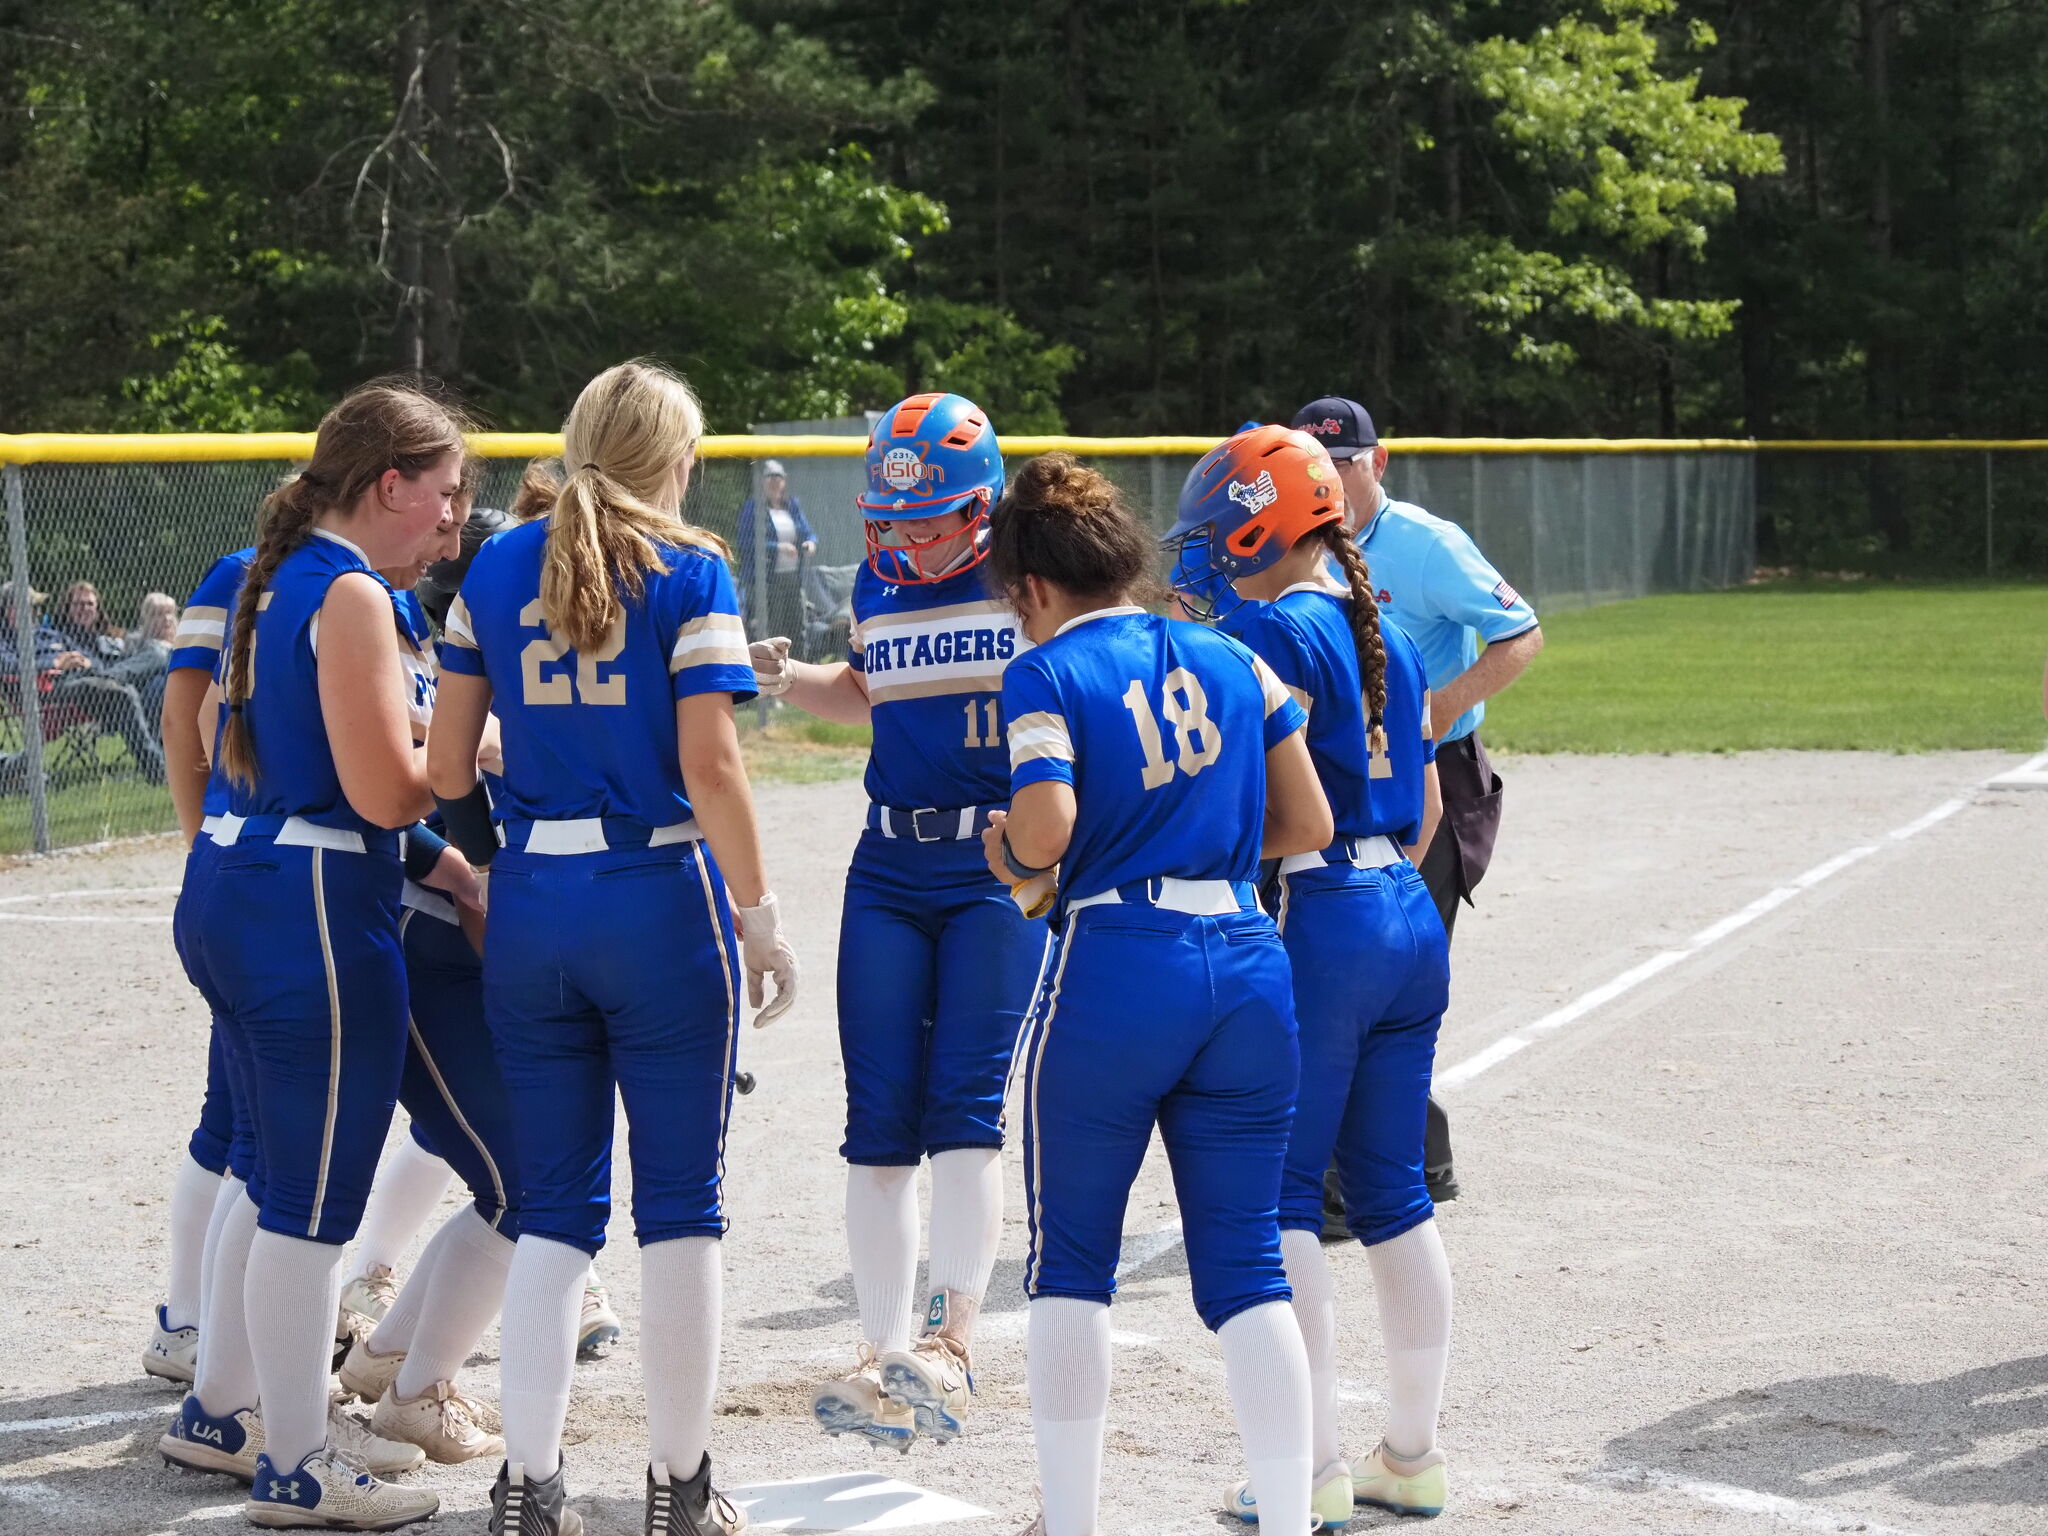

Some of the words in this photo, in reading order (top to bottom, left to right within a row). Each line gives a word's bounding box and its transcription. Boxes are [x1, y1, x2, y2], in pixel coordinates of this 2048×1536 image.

[519, 598, 627, 706] 22
[865, 628, 1015, 674] ORTAGERS
[963, 698, 1001, 748] 11
[1122, 666, 1222, 791] 18
[192, 1421, 223, 1445] UA
